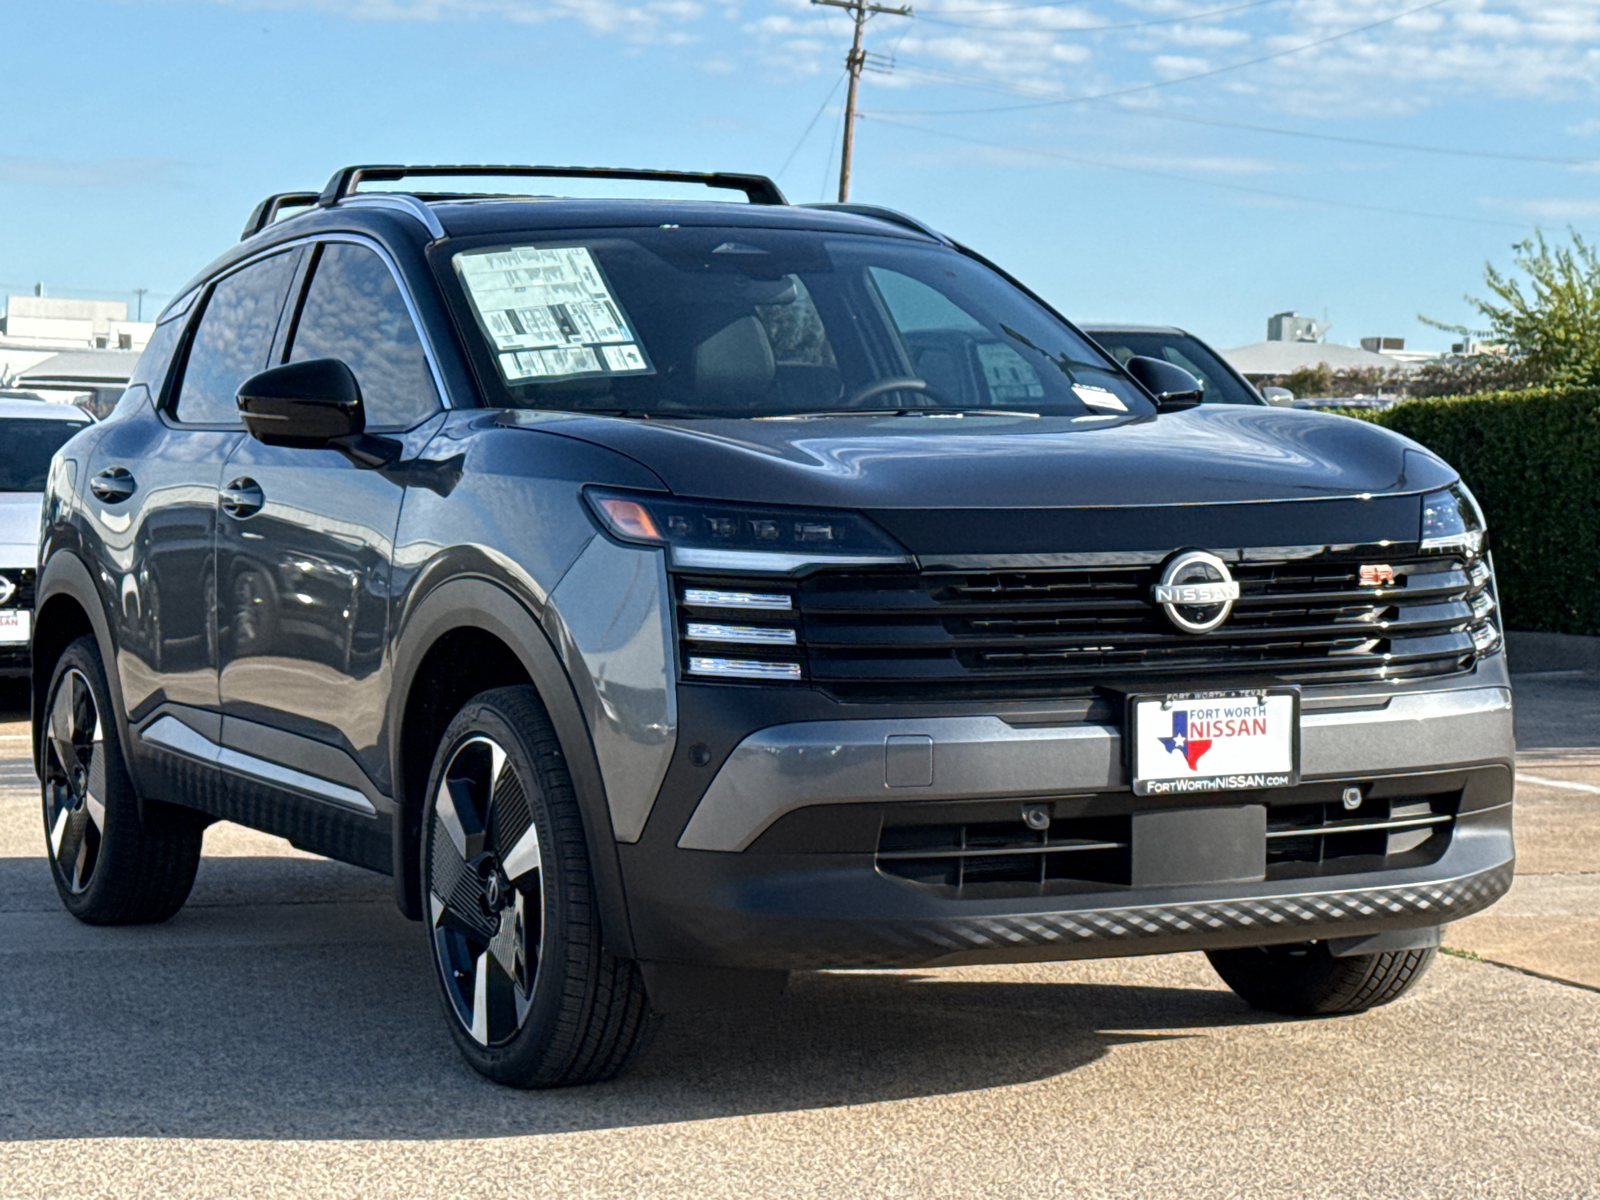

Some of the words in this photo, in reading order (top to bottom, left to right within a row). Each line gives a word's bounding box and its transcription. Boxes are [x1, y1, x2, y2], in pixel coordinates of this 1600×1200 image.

[1359, 564, 1395, 586] SR
[1157, 584, 1235, 601] NISSAN
[1194, 691, 1226, 699] WORTH
[1190, 709, 1221, 720] FORT
[1224, 706, 1266, 718] WORTH
[1190, 718, 1267, 739] NISSAN
